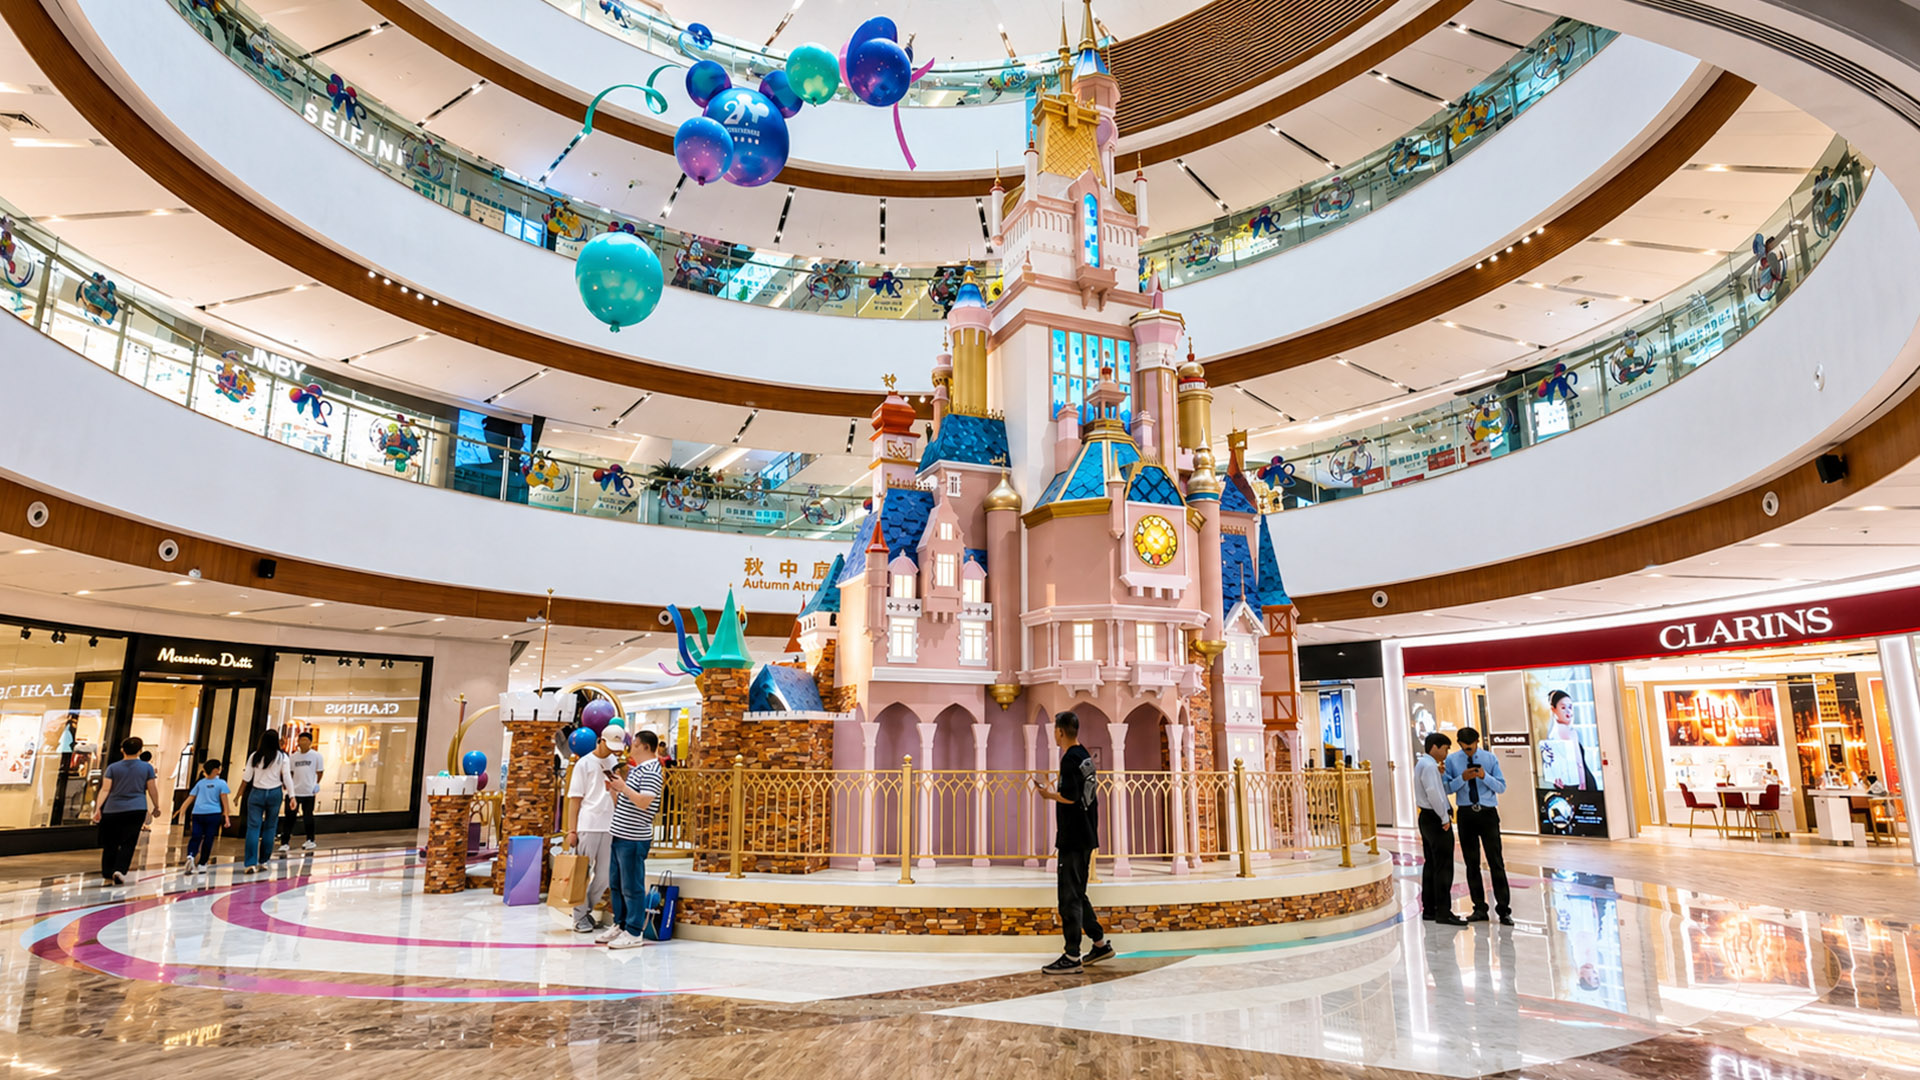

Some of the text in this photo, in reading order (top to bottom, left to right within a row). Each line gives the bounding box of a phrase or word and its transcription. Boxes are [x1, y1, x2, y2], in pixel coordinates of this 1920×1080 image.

[242, 347, 307, 380] JNBY
[744, 557, 831, 580] 秋中庭
[743, 577, 821, 592] Autumn Atriu
[1659, 606, 1834, 650] CLARINS
[157, 647, 253, 669] Massimo Dutti
